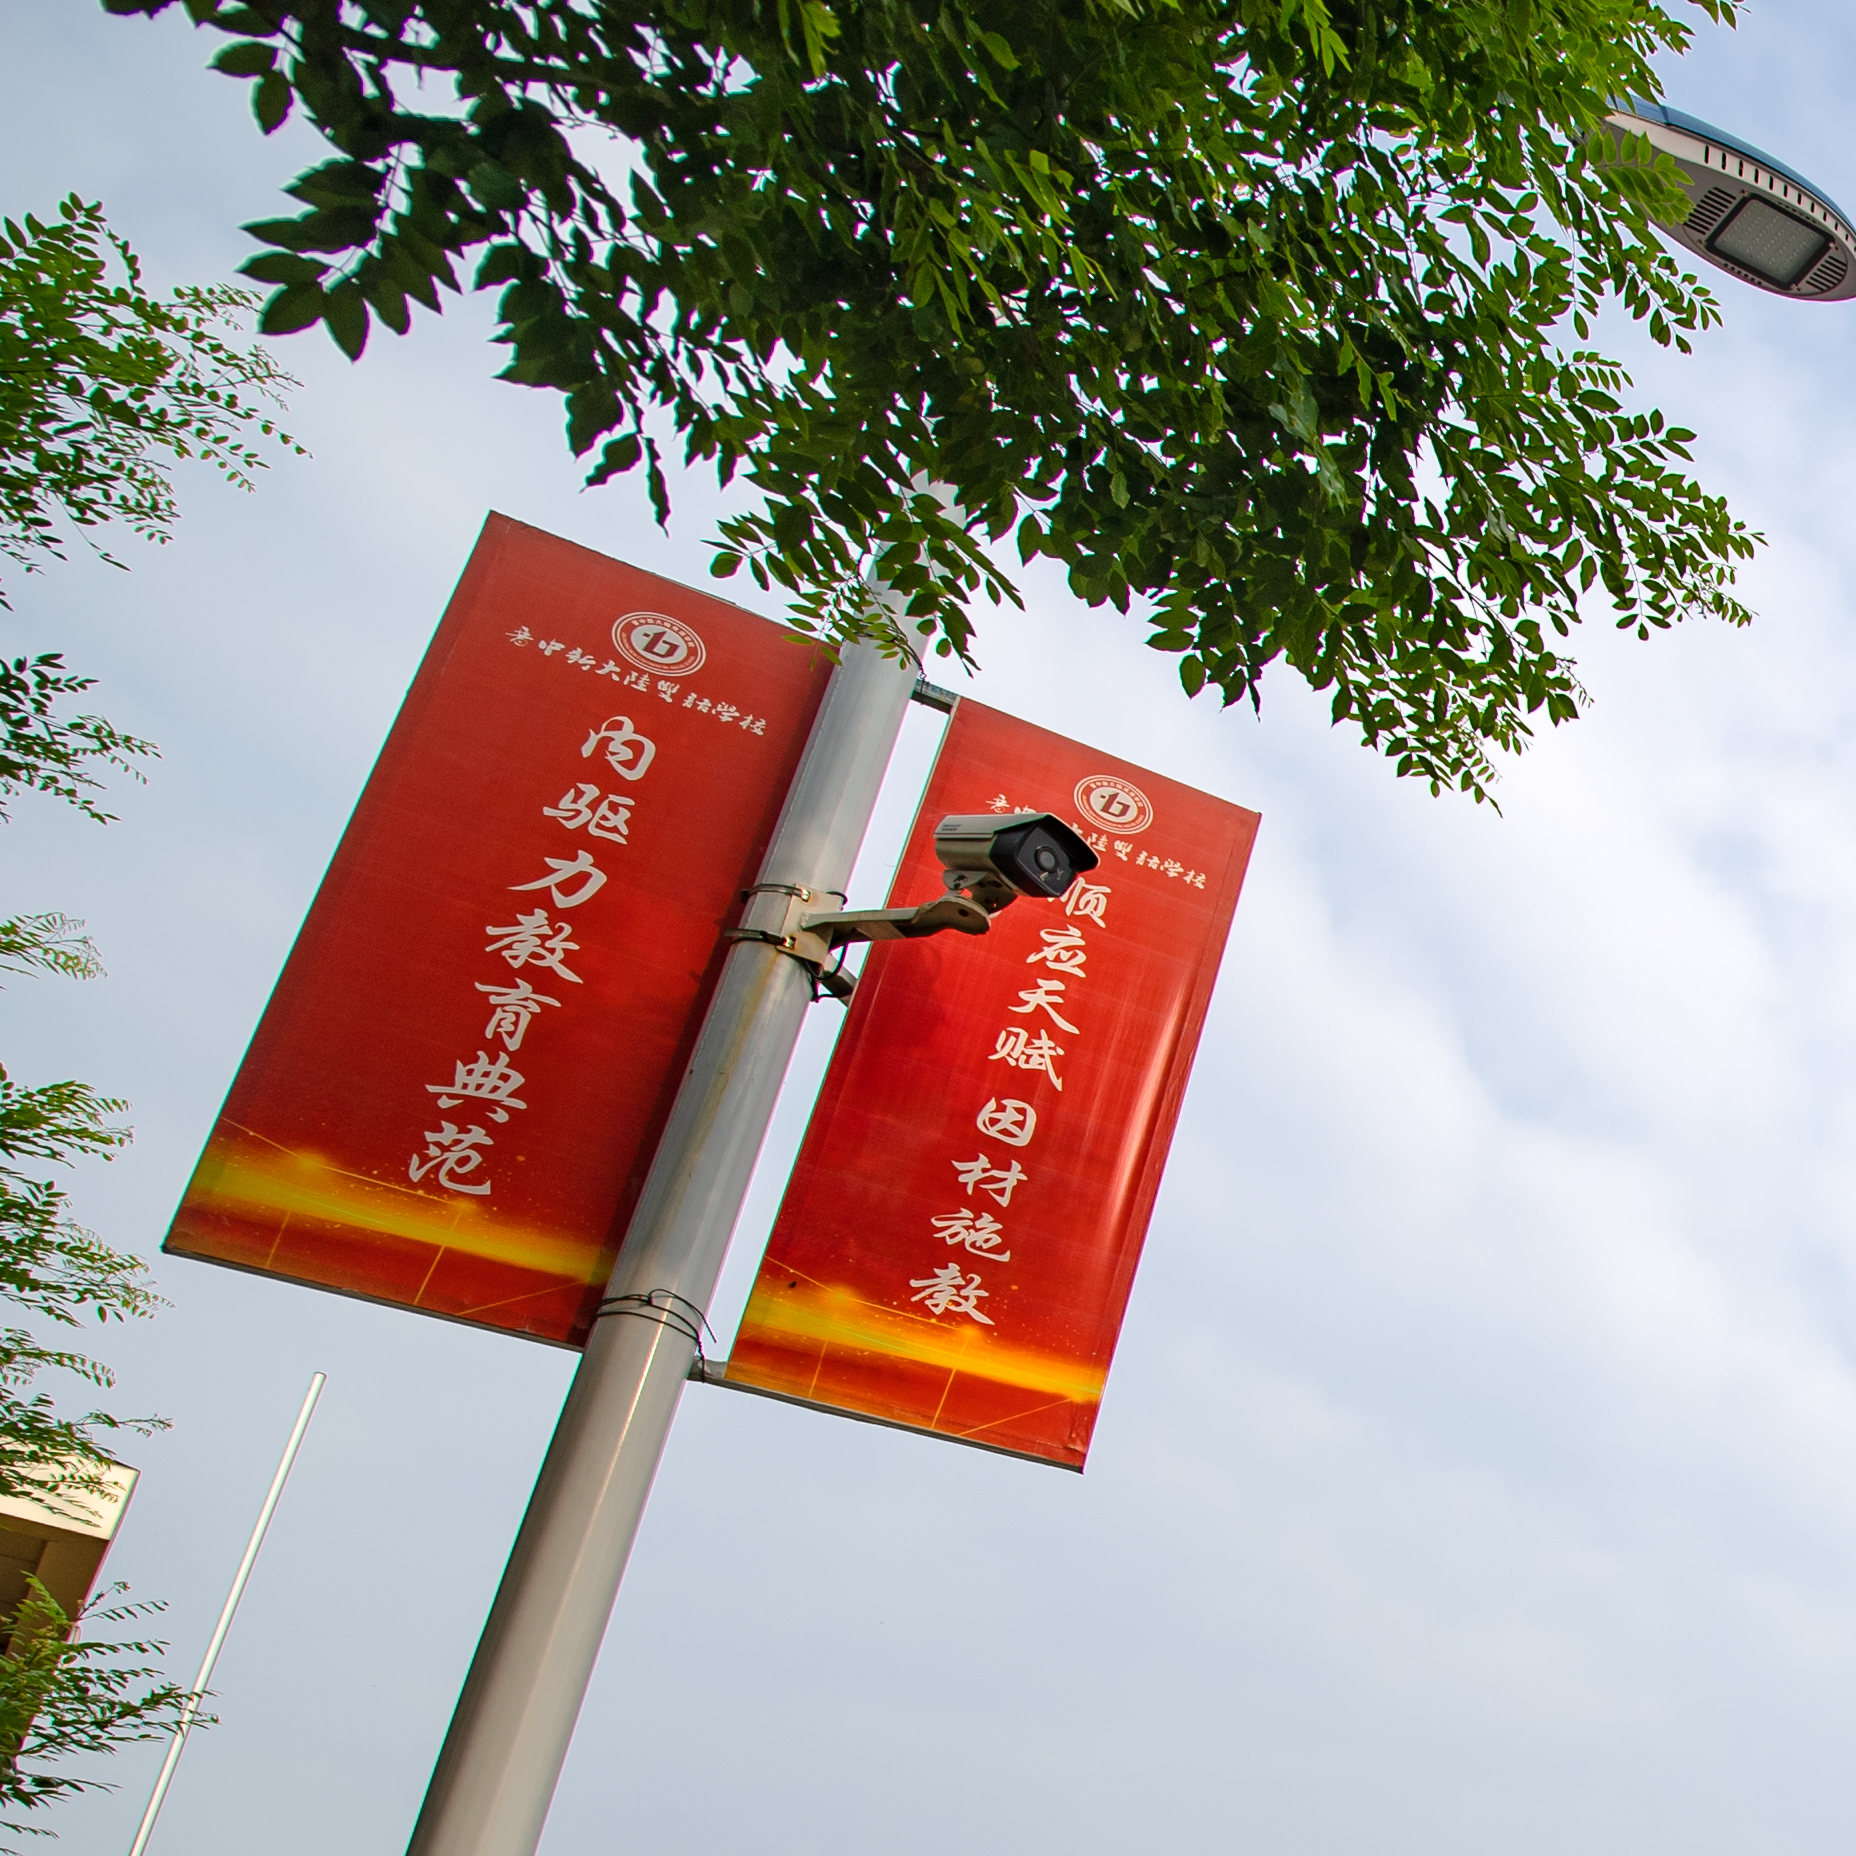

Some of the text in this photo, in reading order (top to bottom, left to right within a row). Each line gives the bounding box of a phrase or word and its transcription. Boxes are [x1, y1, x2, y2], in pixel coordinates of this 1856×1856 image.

[407, 715, 657, 1197] 内驱力教育典范
[908, 875, 1110, 1327] 顺应天赋 因材施教
